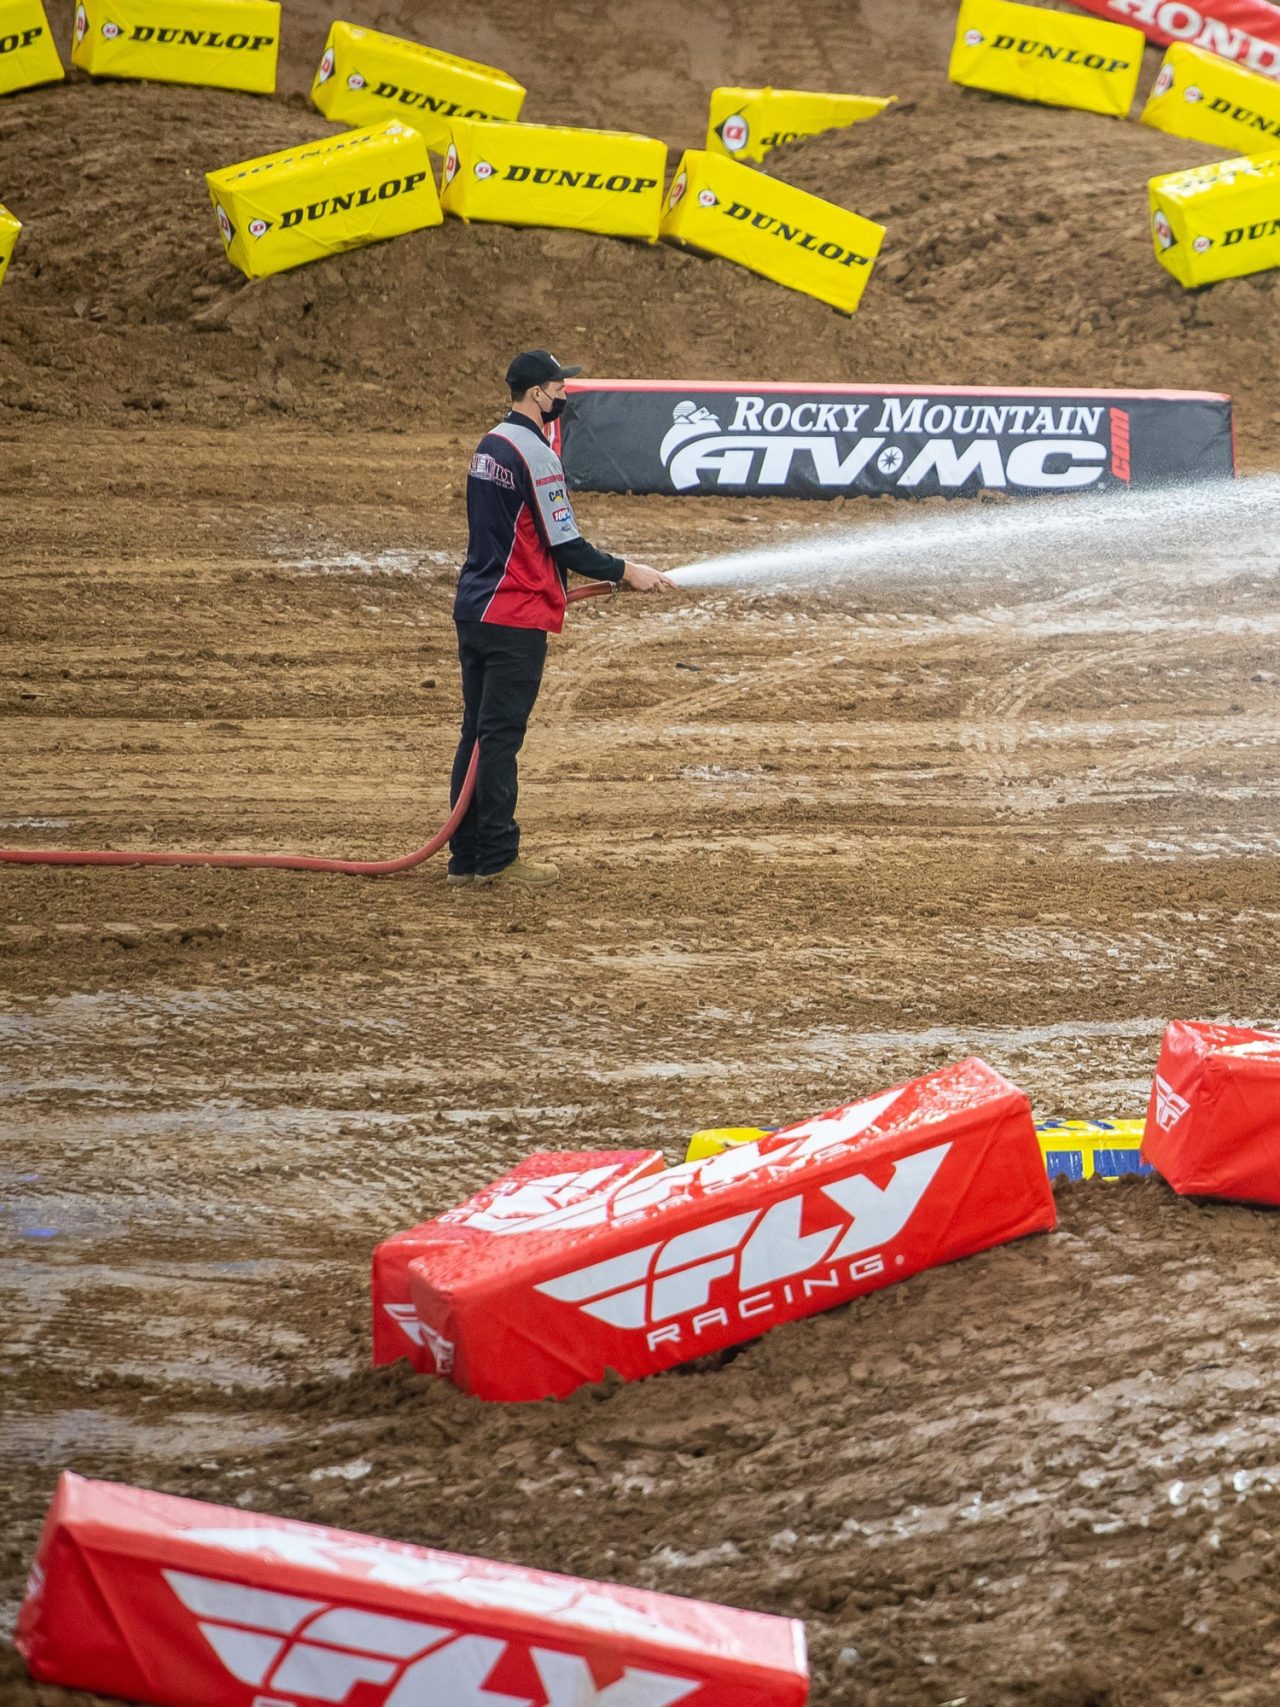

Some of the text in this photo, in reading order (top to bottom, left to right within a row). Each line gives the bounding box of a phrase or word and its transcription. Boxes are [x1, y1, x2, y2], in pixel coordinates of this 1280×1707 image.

[130, 25, 274, 51] DUNLOP
[991, 34, 1130, 73] DUNLOP
[371, 81, 516, 120] DUNLO
[503, 165, 657, 194] DUNLOP
[279, 171, 426, 230] DUNLOP
[723, 201, 868, 267] DUNLOP
[728, 397, 1104, 435] ROCKY MOUNTAIN
[549, 489, 564, 502] CAT
[533, 1142, 953, 1330] FLY
[646, 1254, 884, 1352] RACING
